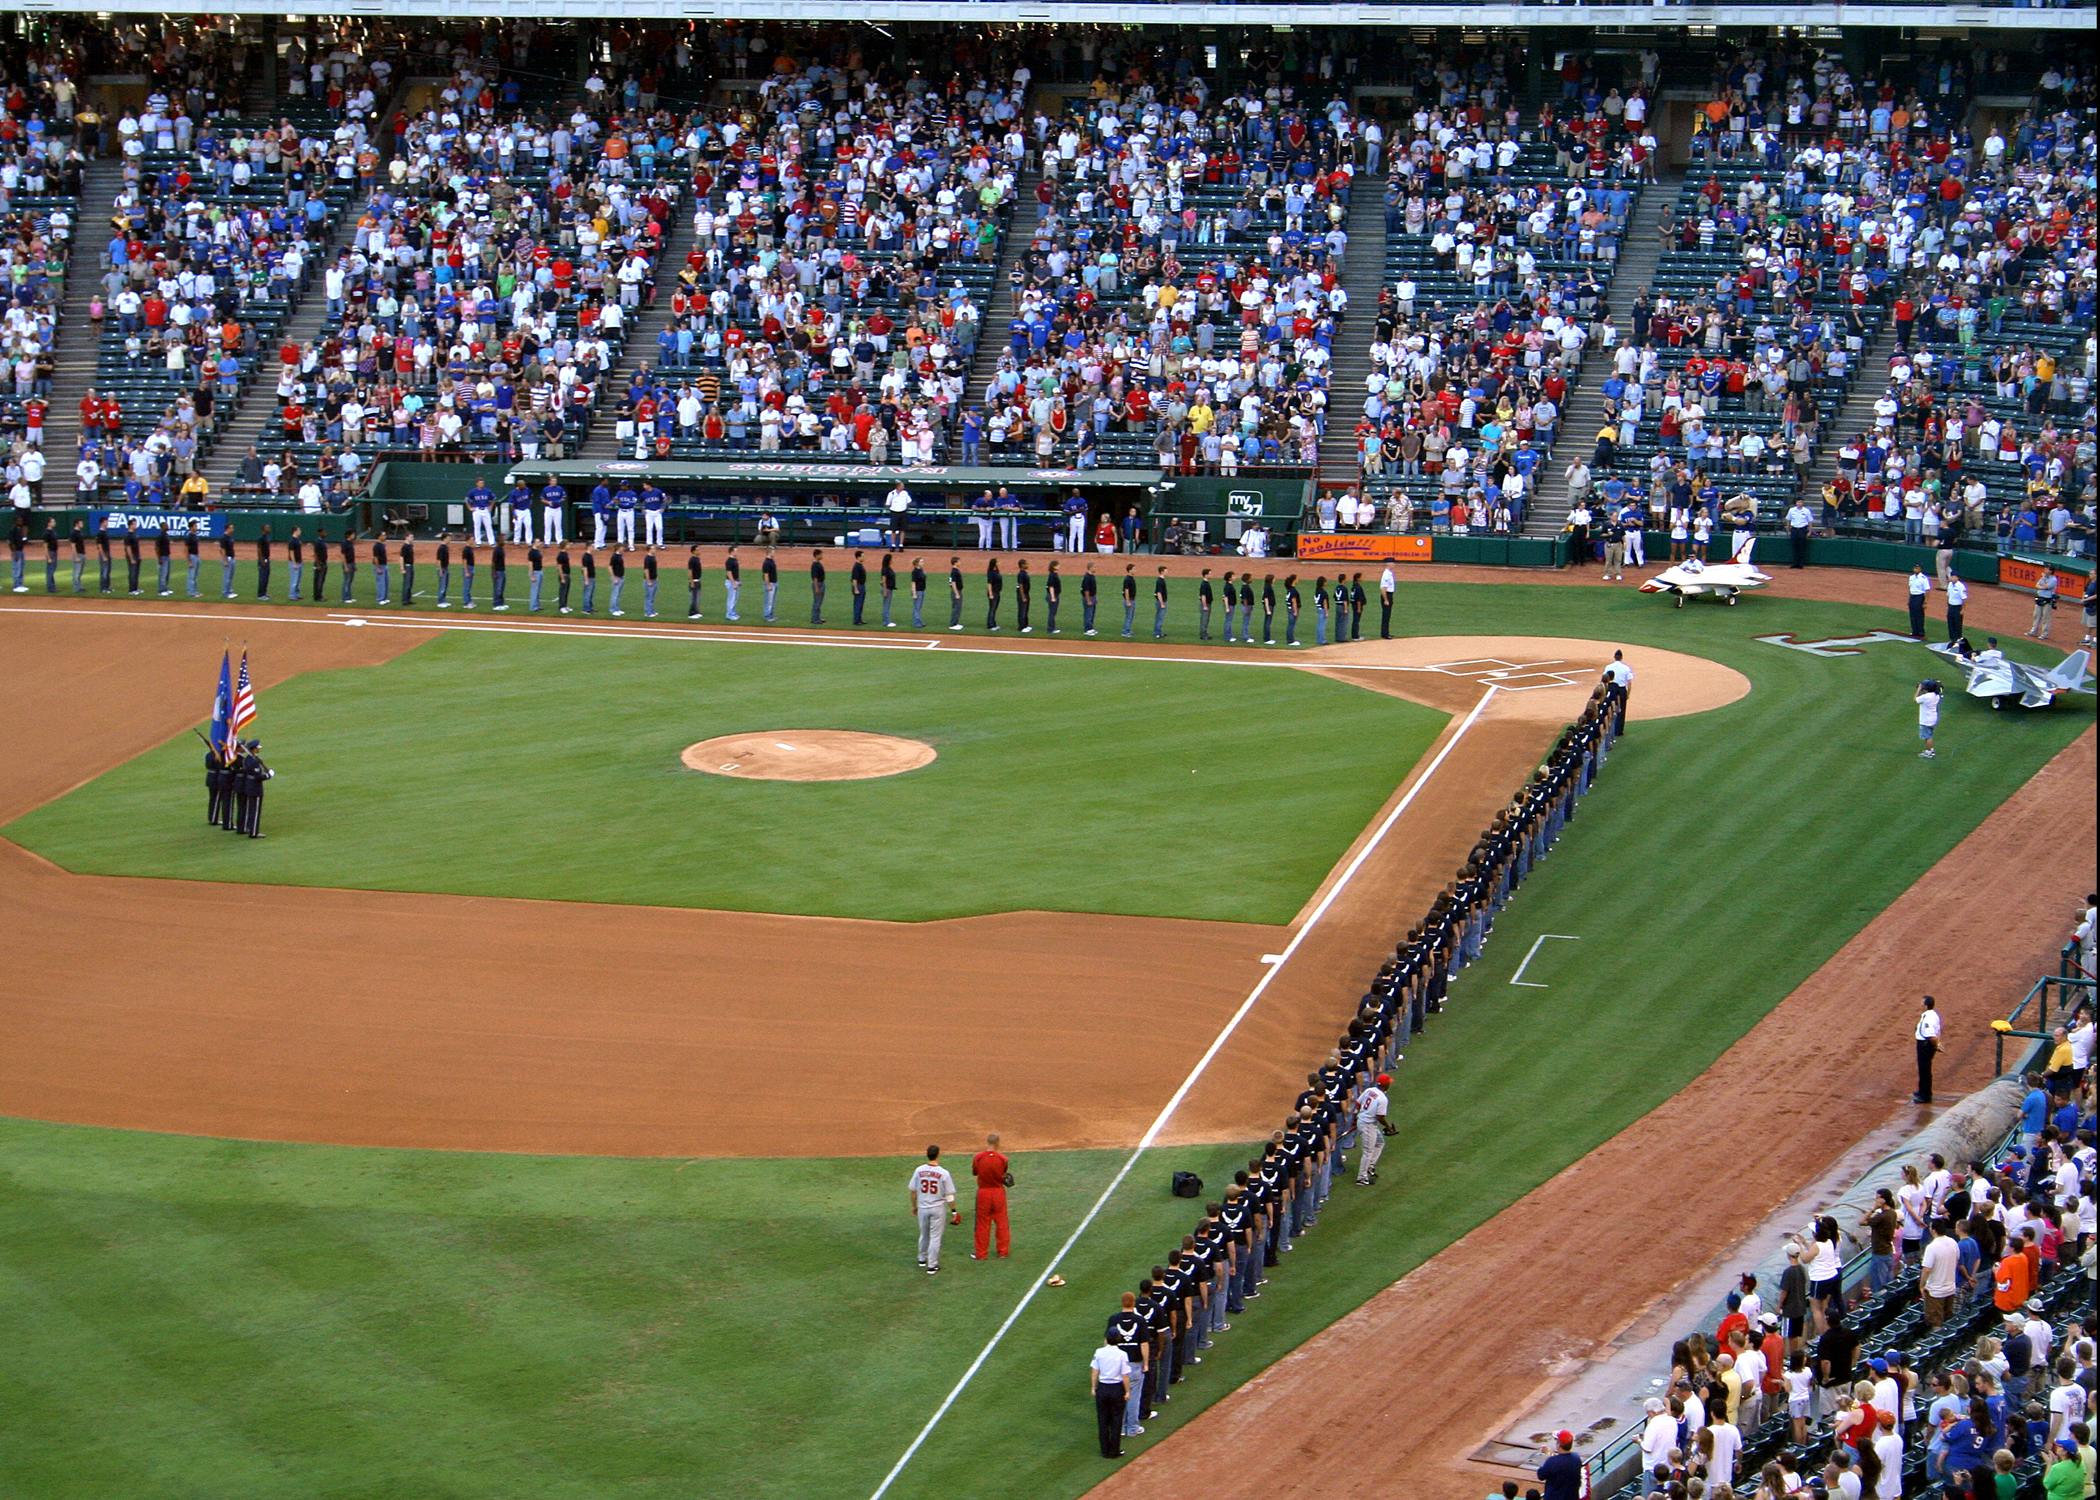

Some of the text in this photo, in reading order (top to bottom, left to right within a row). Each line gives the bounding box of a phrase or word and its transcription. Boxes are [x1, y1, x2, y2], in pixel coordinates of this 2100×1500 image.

[1229, 495, 1251, 510] my
[1246, 503, 1263, 516] 27
[2008, 566, 2037, 582] TEXAS
[920, 1179, 939, 1195] 35
[1973, 1436, 1984, 1449] 9
